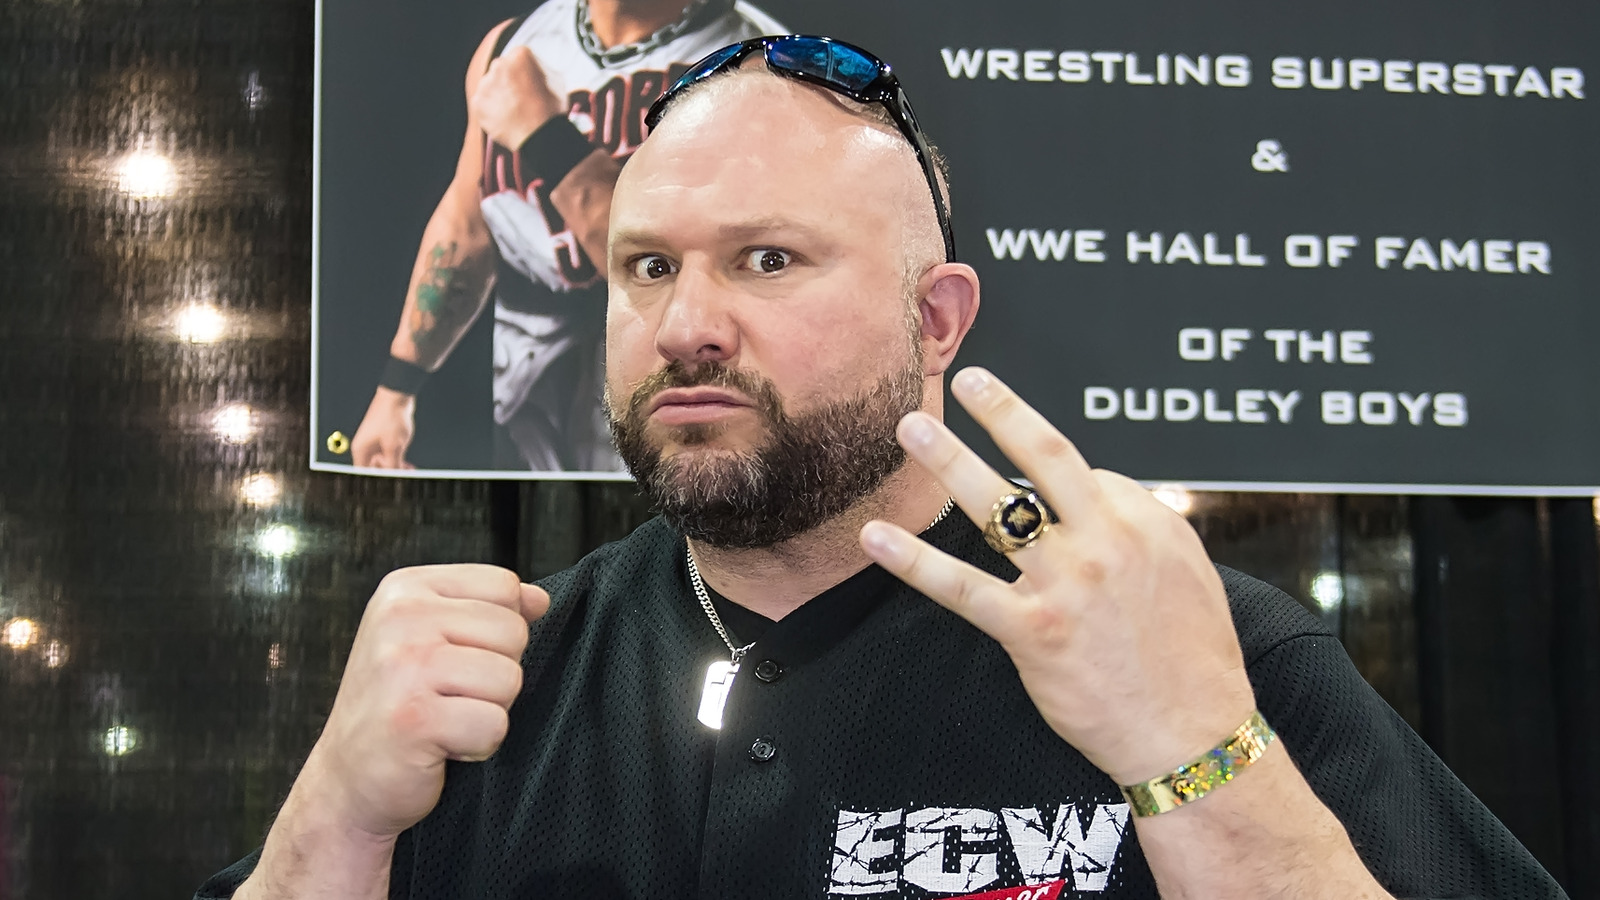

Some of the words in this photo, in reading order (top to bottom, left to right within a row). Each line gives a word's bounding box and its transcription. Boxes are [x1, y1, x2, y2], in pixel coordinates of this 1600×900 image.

[941, 48, 1251, 87] WRESTLING
[1271, 57, 1584, 99] SUPERSTAR
[1251, 139, 1288, 172] &
[985, 228, 1106, 263] WWE
[1126, 231, 1266, 267] HALL
[1284, 234, 1358, 268] OF
[1375, 236, 1551, 274] FAMER
[1178, 327, 1251, 361] OF
[1265, 329, 1372, 364] THE
[1084, 386, 1300, 423] DUDLEY
[1321, 390, 1468, 427] BOYS
[828, 802, 1130, 894] ECW
